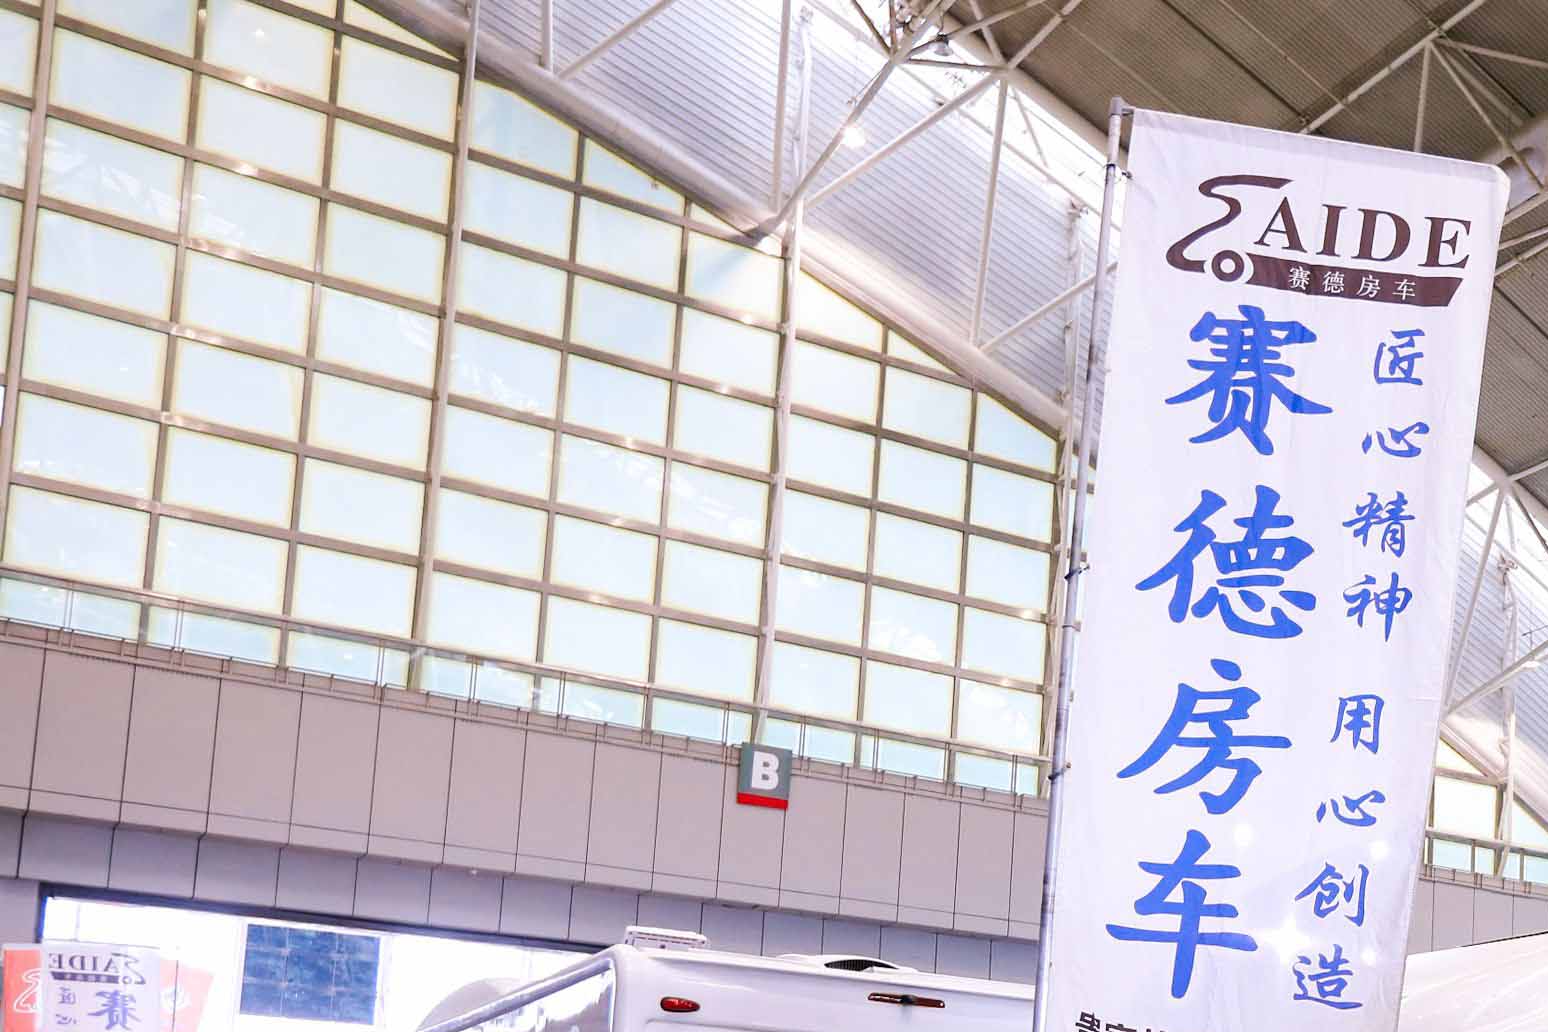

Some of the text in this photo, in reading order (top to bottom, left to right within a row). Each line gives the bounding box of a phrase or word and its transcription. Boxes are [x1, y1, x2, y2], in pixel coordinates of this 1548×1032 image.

[1288, 264, 1417, 302] 赛德房车
[1106, 303, 1334, 1000] 赛德房车
[751, 750, 779, 790] B
